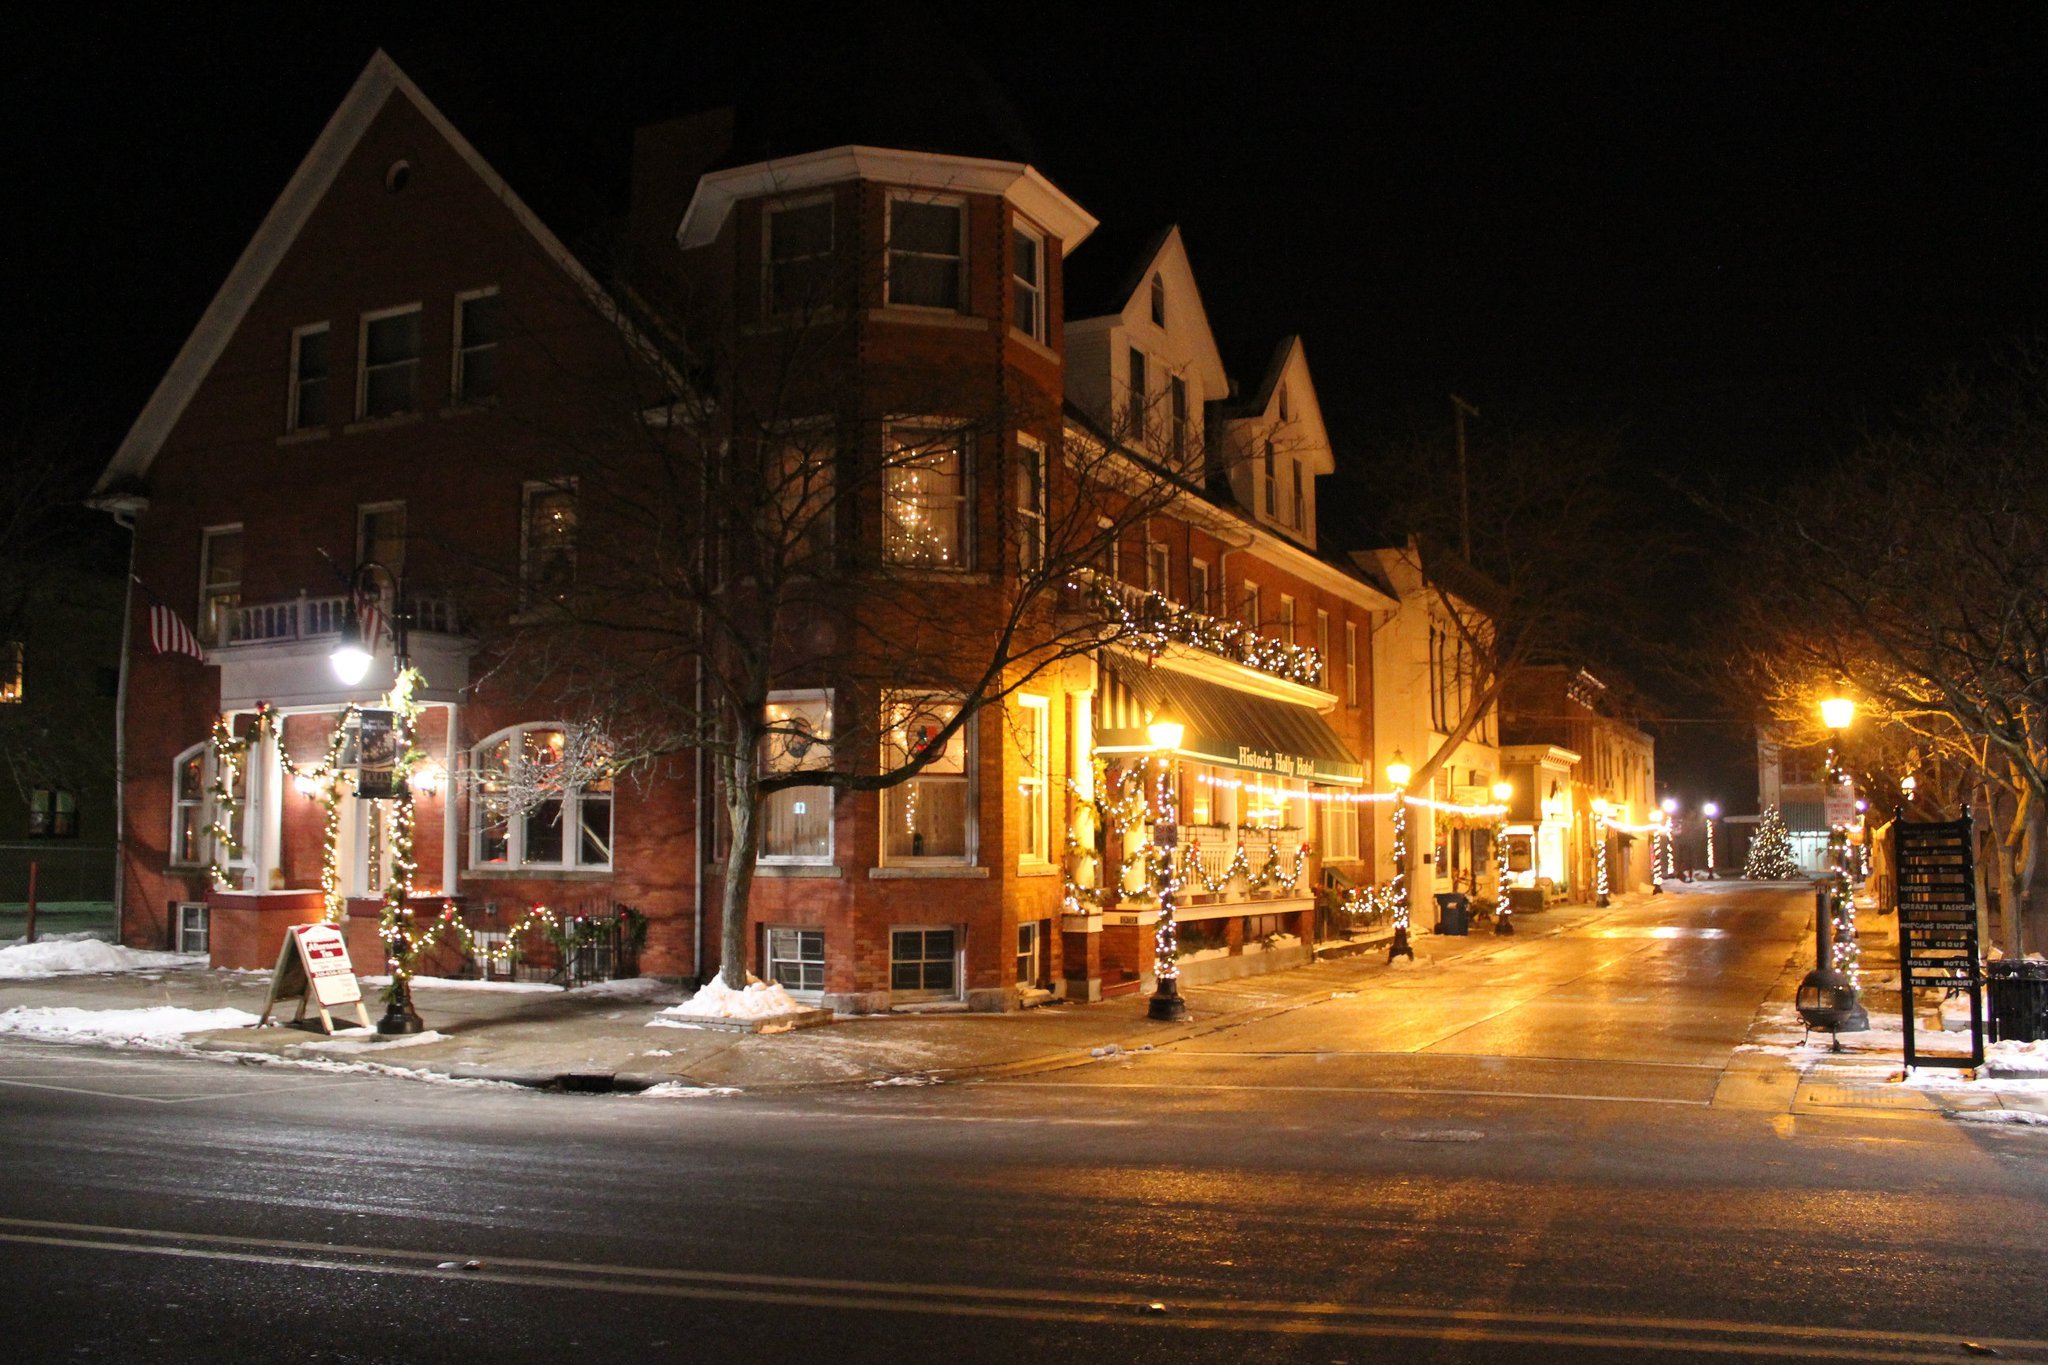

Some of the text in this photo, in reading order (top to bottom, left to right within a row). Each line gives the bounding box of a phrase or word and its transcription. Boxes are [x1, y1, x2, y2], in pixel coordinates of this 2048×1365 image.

[1239, 746, 1315, 777] Historic Holly Hotel
